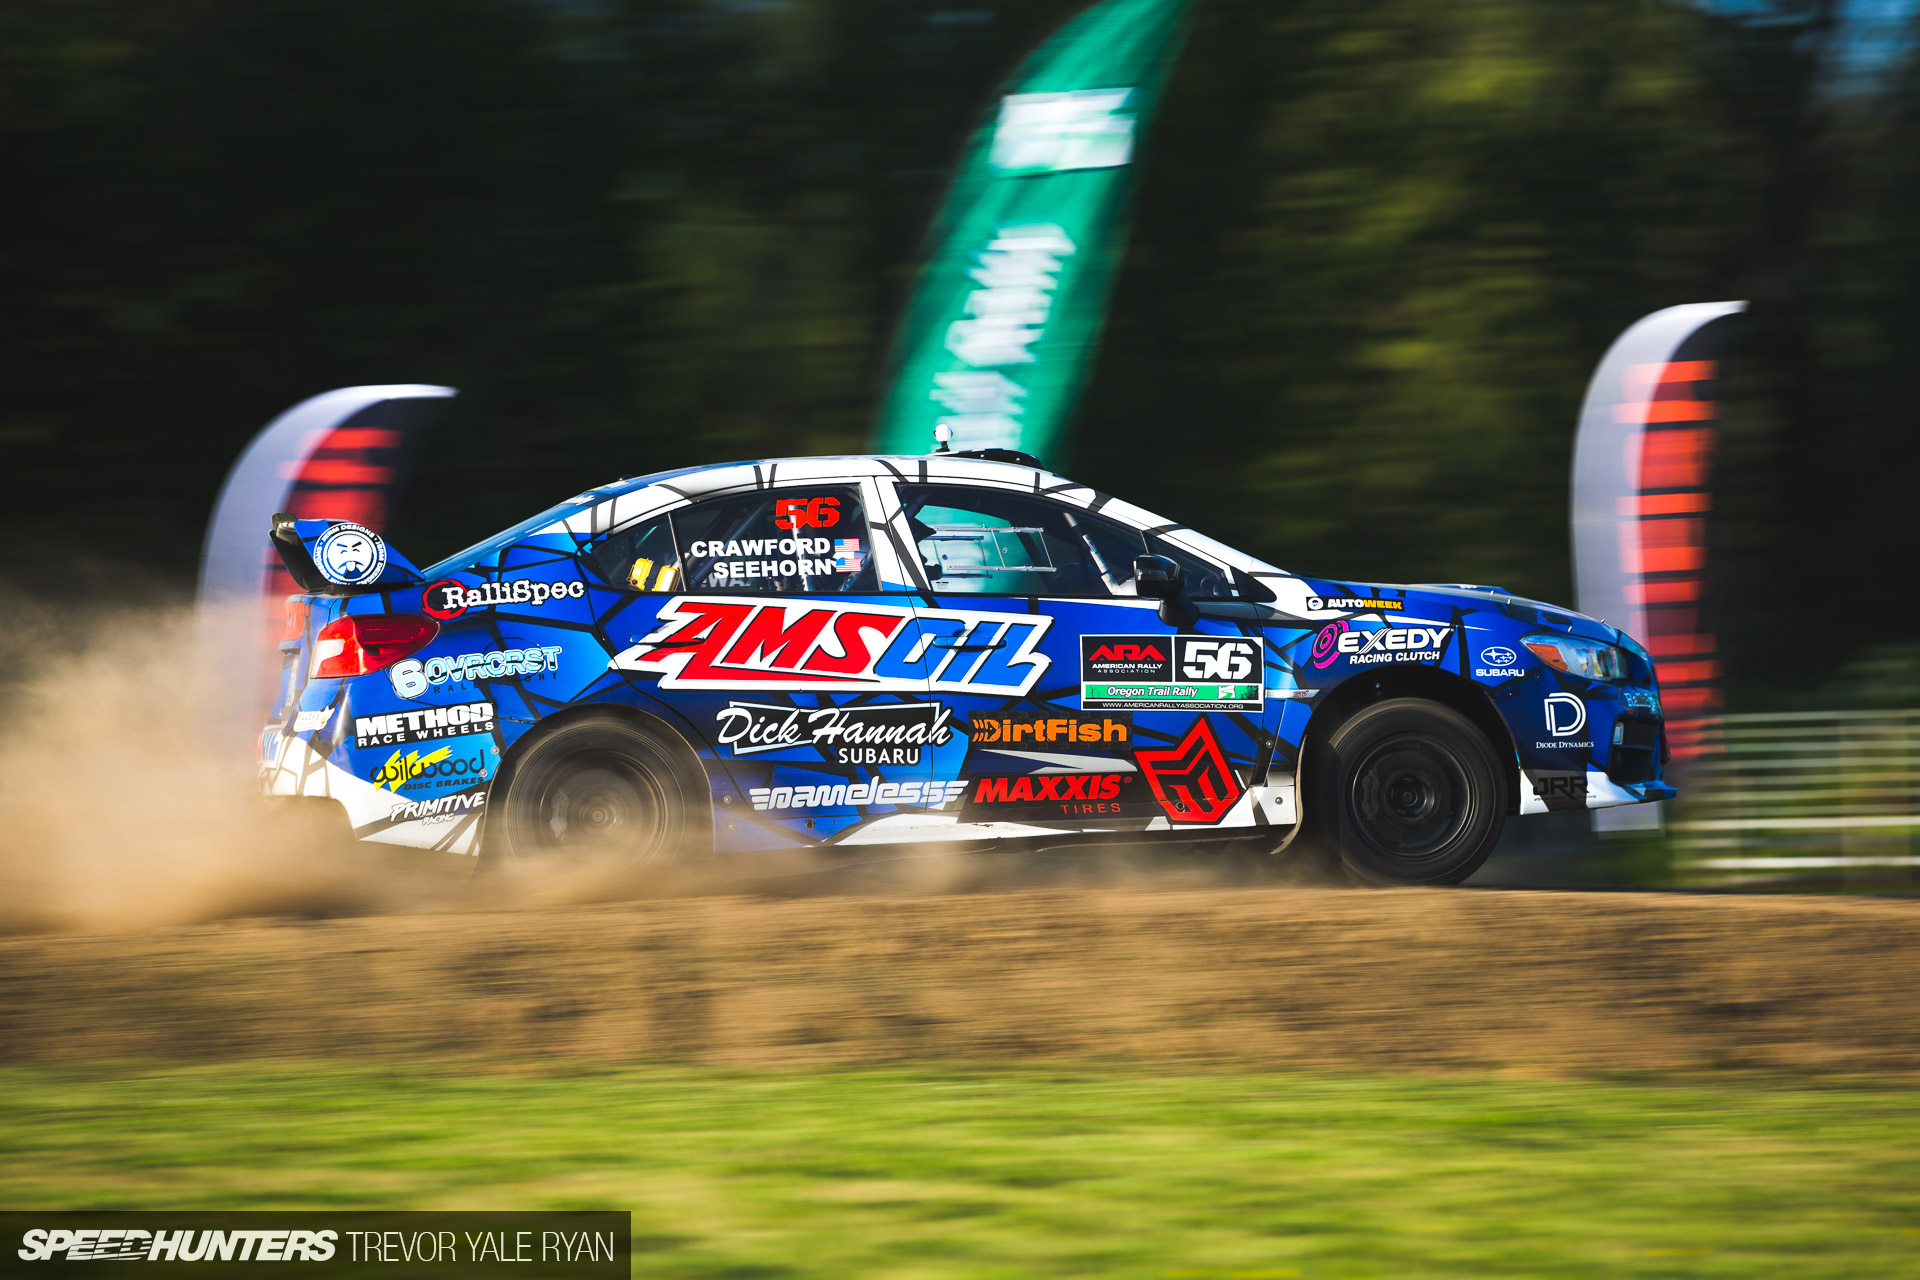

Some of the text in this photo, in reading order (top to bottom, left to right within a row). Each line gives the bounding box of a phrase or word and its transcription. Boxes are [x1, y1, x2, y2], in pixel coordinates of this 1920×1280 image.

[774, 496, 841, 529] 56
[690, 537, 831, 559] CRAWFORD
[713, 559, 832, 579] SEEHORN
[441, 579, 585, 610] RalliSpec
[1327, 598, 1403, 610] AUTOWEEK
[635, 601, 1037, 688] AMSOIL
[1337, 627, 1451, 655] EXEDY
[1088, 644, 1167, 661] ARA
[1182, 641, 1254, 680] 56
[1349, 650, 1440, 665] RACING CLUTCH
[1475, 668, 1525, 677] SUBARU
[1106, 686, 1199, 698] Oregon Trail Rally
[1102, 701, 1244, 710] WWW.AMERICANRALLYASSOCIATION.ORG
[355, 701, 494, 738] METHOD
[716, 707, 952, 745] Dick Hannah
[971, 718, 1128, 743] DirtFish
[357, 721, 495, 748] RACE WHEELS
[1535, 741, 1595, 749] DIODE DYNAMICS
[369, 748, 486, 783] wilwood
[838, 748, 919, 765] SUBARU
[403, 776, 485, 791] DISC BRAKES
[765, 776, 950, 810] nameless
[389, 791, 487, 822] PRIMITIVE
[1060, 802, 1122, 815] TIRES
[421, 812, 455, 826] RACING
